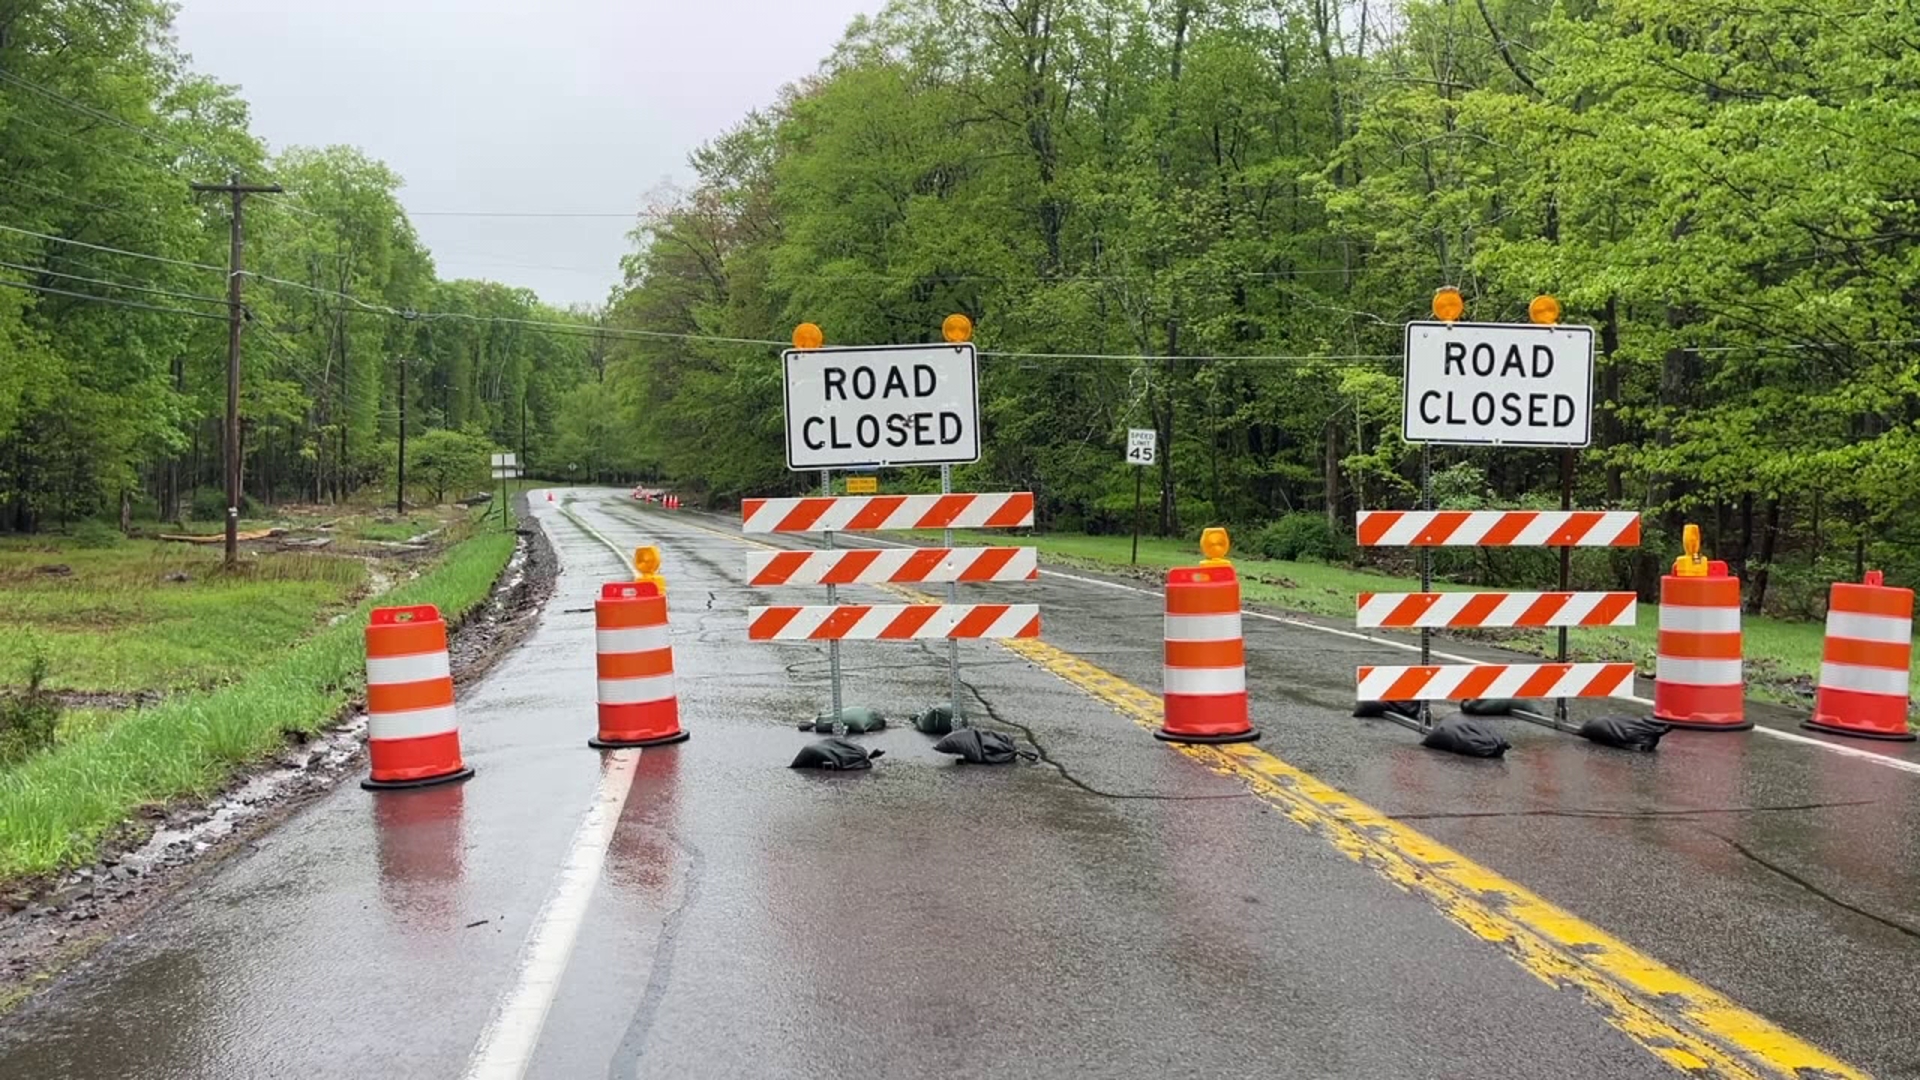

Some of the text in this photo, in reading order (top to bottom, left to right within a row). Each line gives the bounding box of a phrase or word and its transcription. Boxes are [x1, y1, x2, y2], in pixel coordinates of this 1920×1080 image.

[1444, 342, 1554, 379] ROAD
[824, 364, 937, 401] ROAD
[1419, 390, 1575, 427] CLOSED
[803, 411, 962, 451] CLOSED
[1130, 432, 1154, 440] SPEED
[1129, 447, 1153, 461] 45
